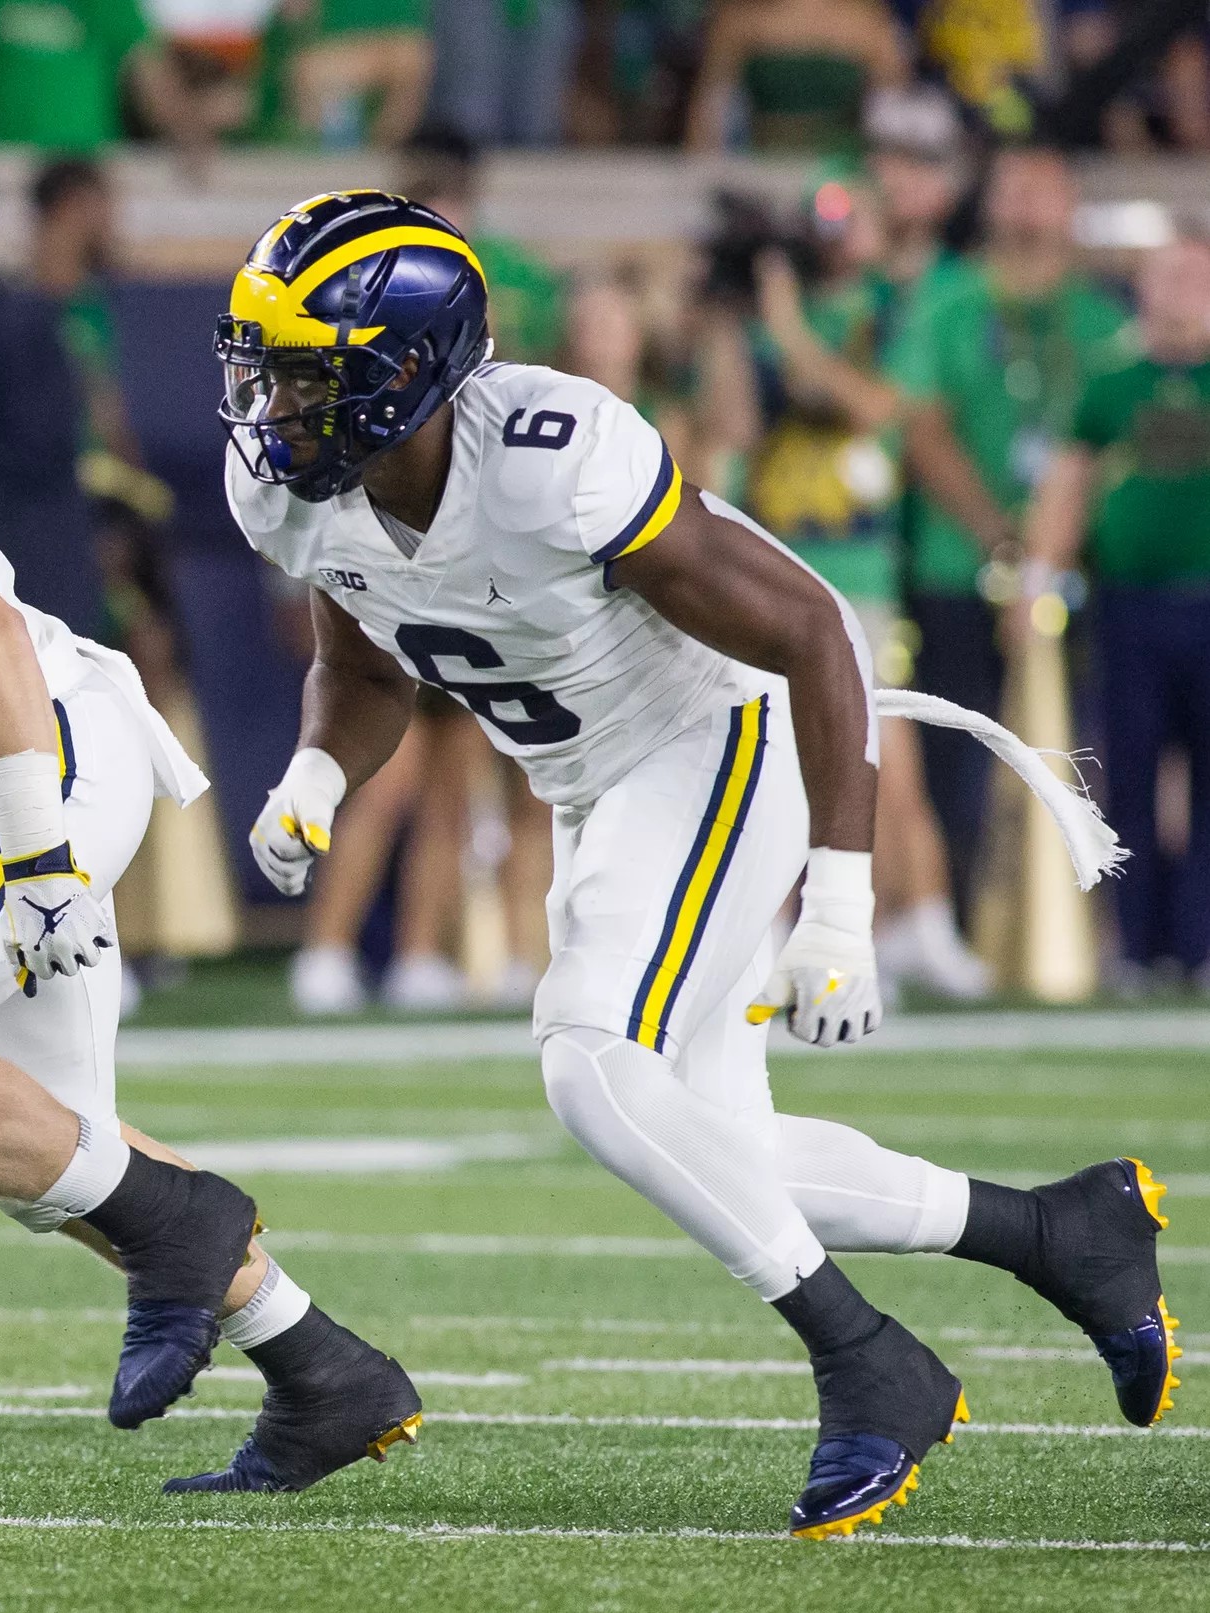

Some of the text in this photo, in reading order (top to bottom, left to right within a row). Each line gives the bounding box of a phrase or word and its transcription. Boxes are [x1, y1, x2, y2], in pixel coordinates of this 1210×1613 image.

[502, 407, 578, 451] 6
[318, 568, 368, 592] BIG
[394, 622, 582, 745] 6
